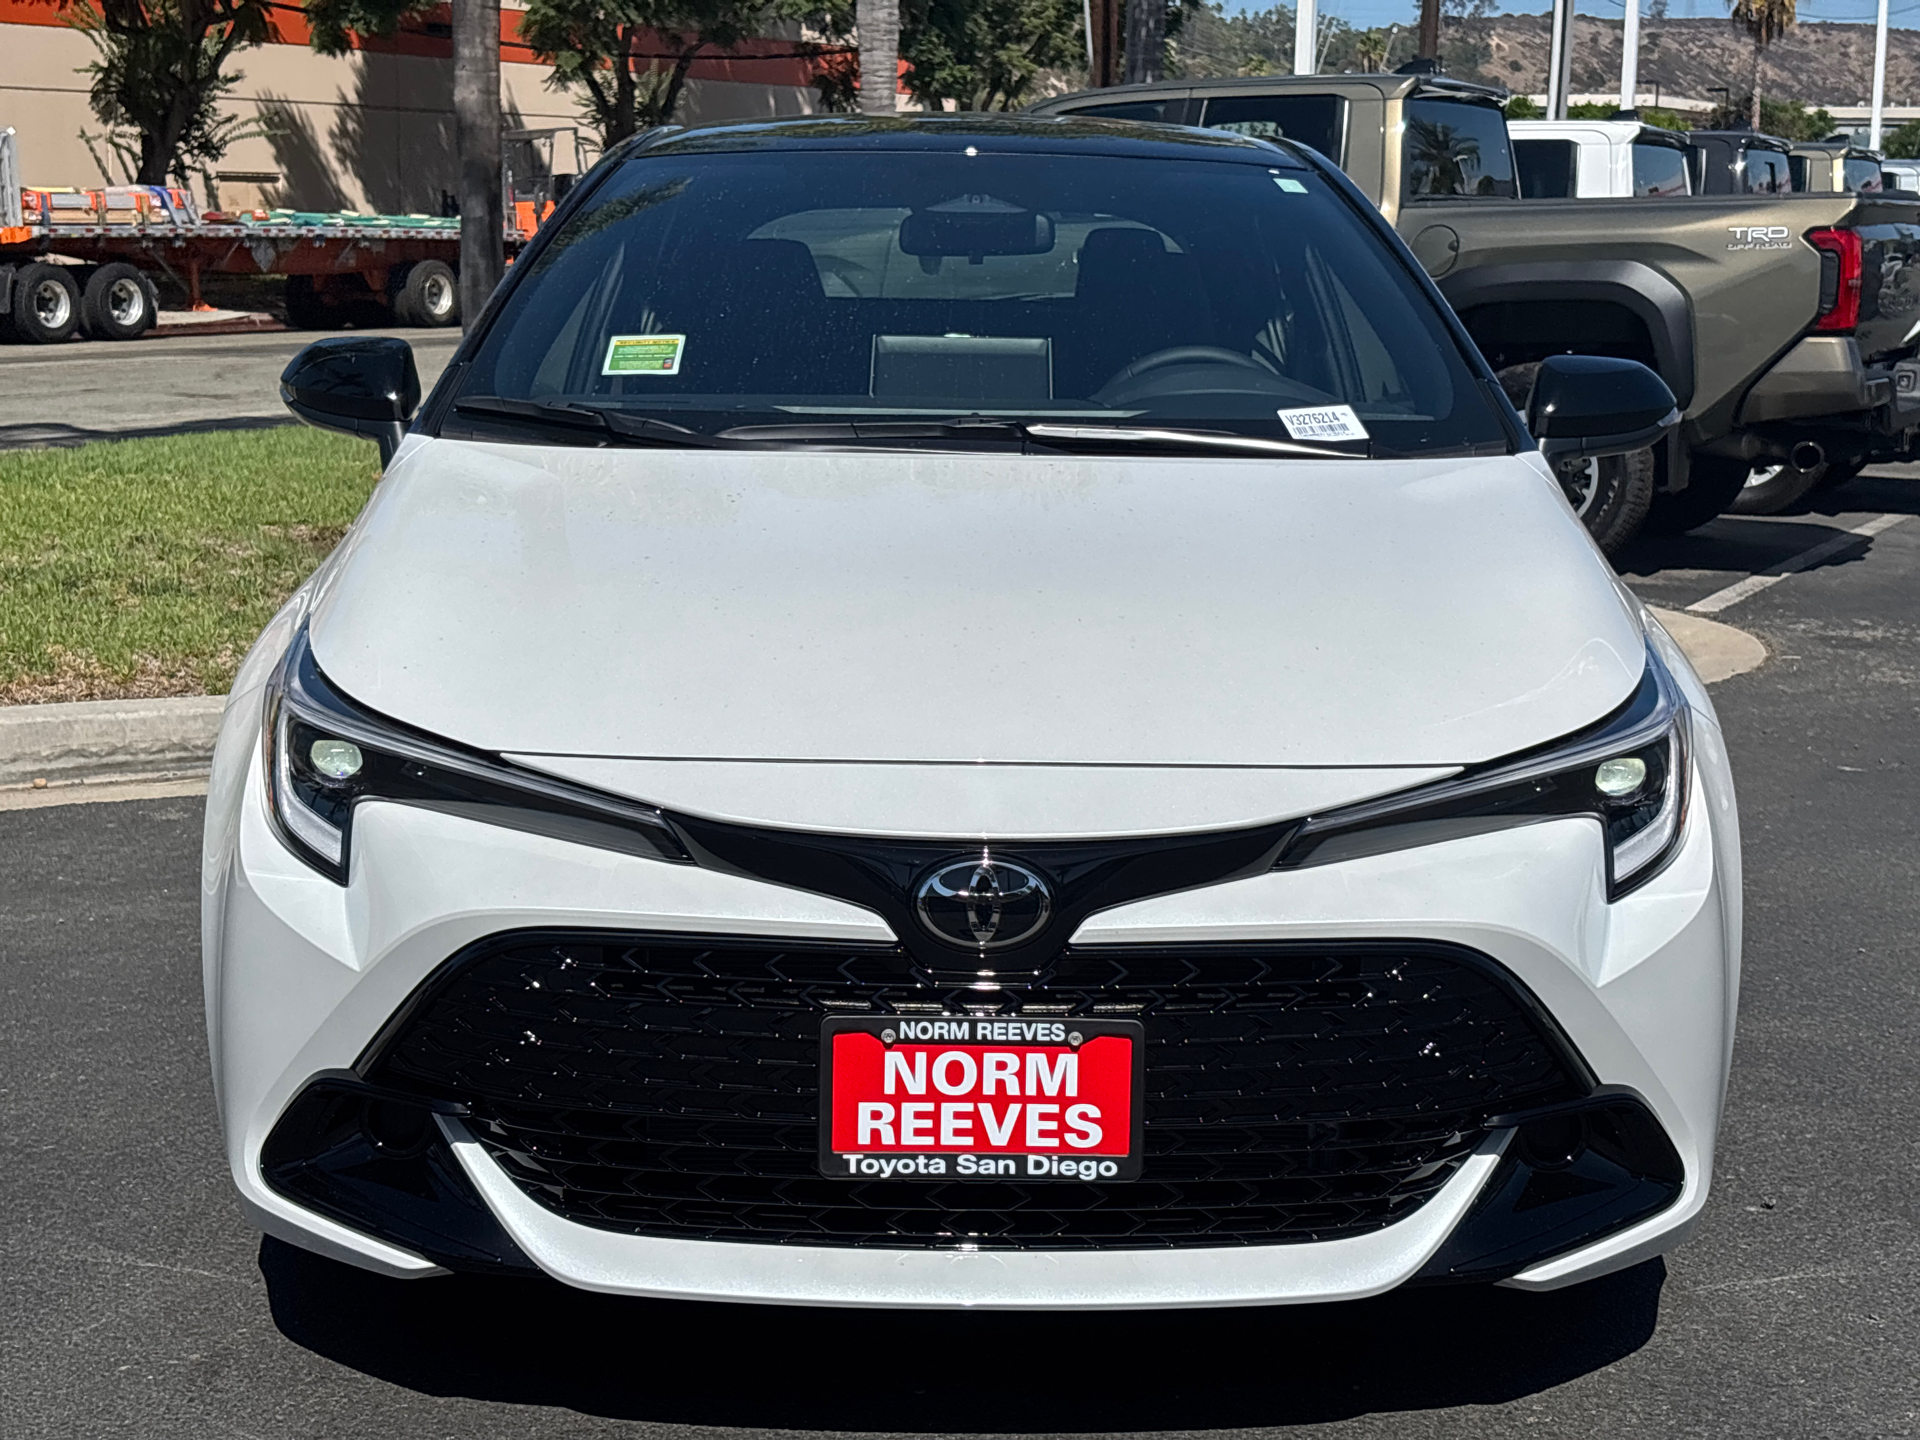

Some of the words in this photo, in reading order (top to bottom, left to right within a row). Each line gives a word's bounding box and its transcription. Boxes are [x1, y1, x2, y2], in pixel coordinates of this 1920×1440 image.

[1728, 226, 1789, 242] TRD
[1285, 411, 1341, 426] V3276214
[900, 1021, 970, 1040] NORM
[977, 1022, 1066, 1042] REEVES
[884, 1051, 1078, 1097] NORM
[857, 1102, 1103, 1148] REEVES
[843, 1154, 946, 1178] Toyota
[956, 1154, 1016, 1175] San
[1027, 1155, 1118, 1180] Diego
